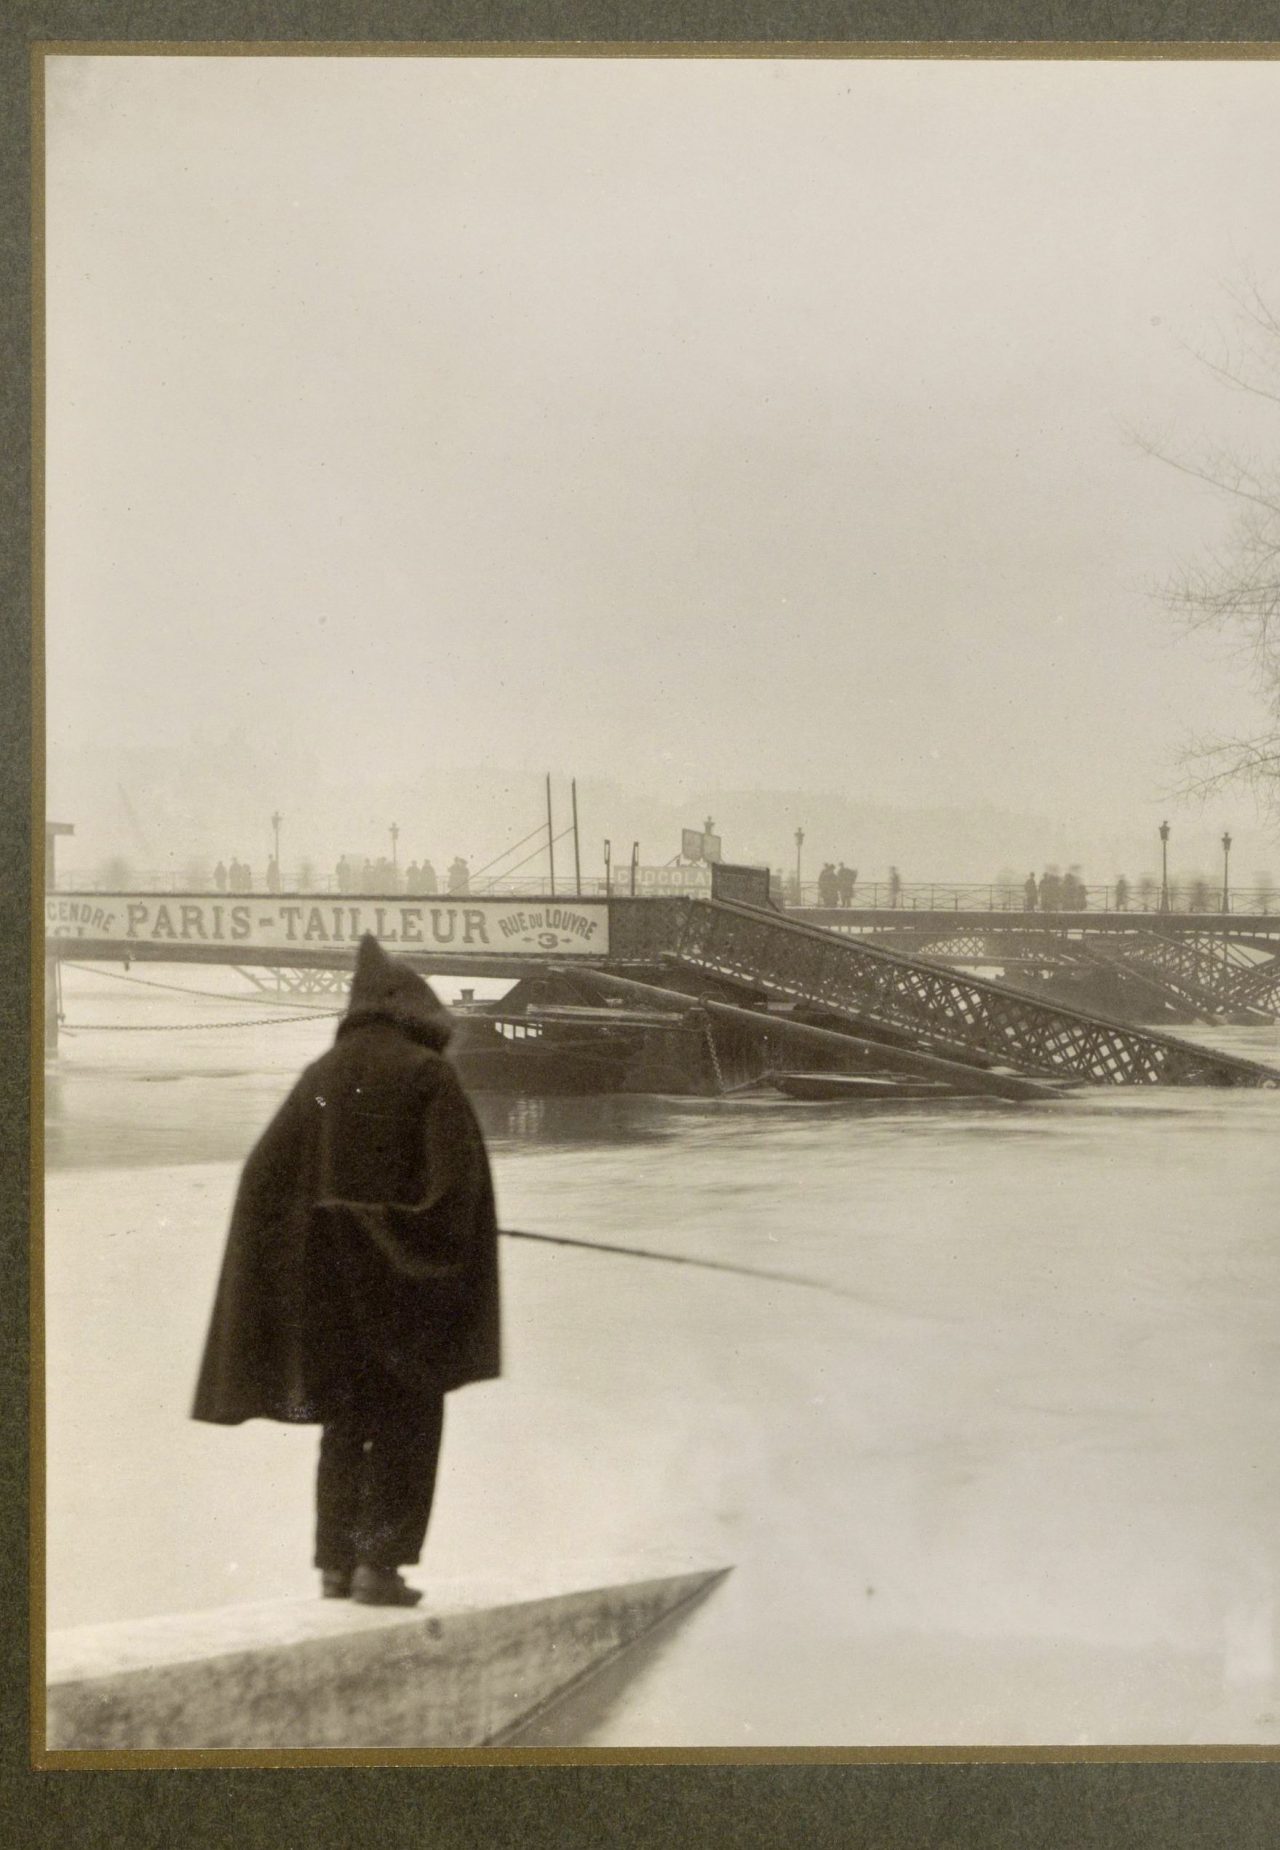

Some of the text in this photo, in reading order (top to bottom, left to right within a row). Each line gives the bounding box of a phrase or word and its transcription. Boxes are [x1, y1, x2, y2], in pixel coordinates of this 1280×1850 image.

[126, 904, 490, 943] PARIS-TAILLEUR
[497, 911, 529, 938] RUE
[545, 908, 598, 941] LOUVRE
[537, 932, 559, 949] 3
